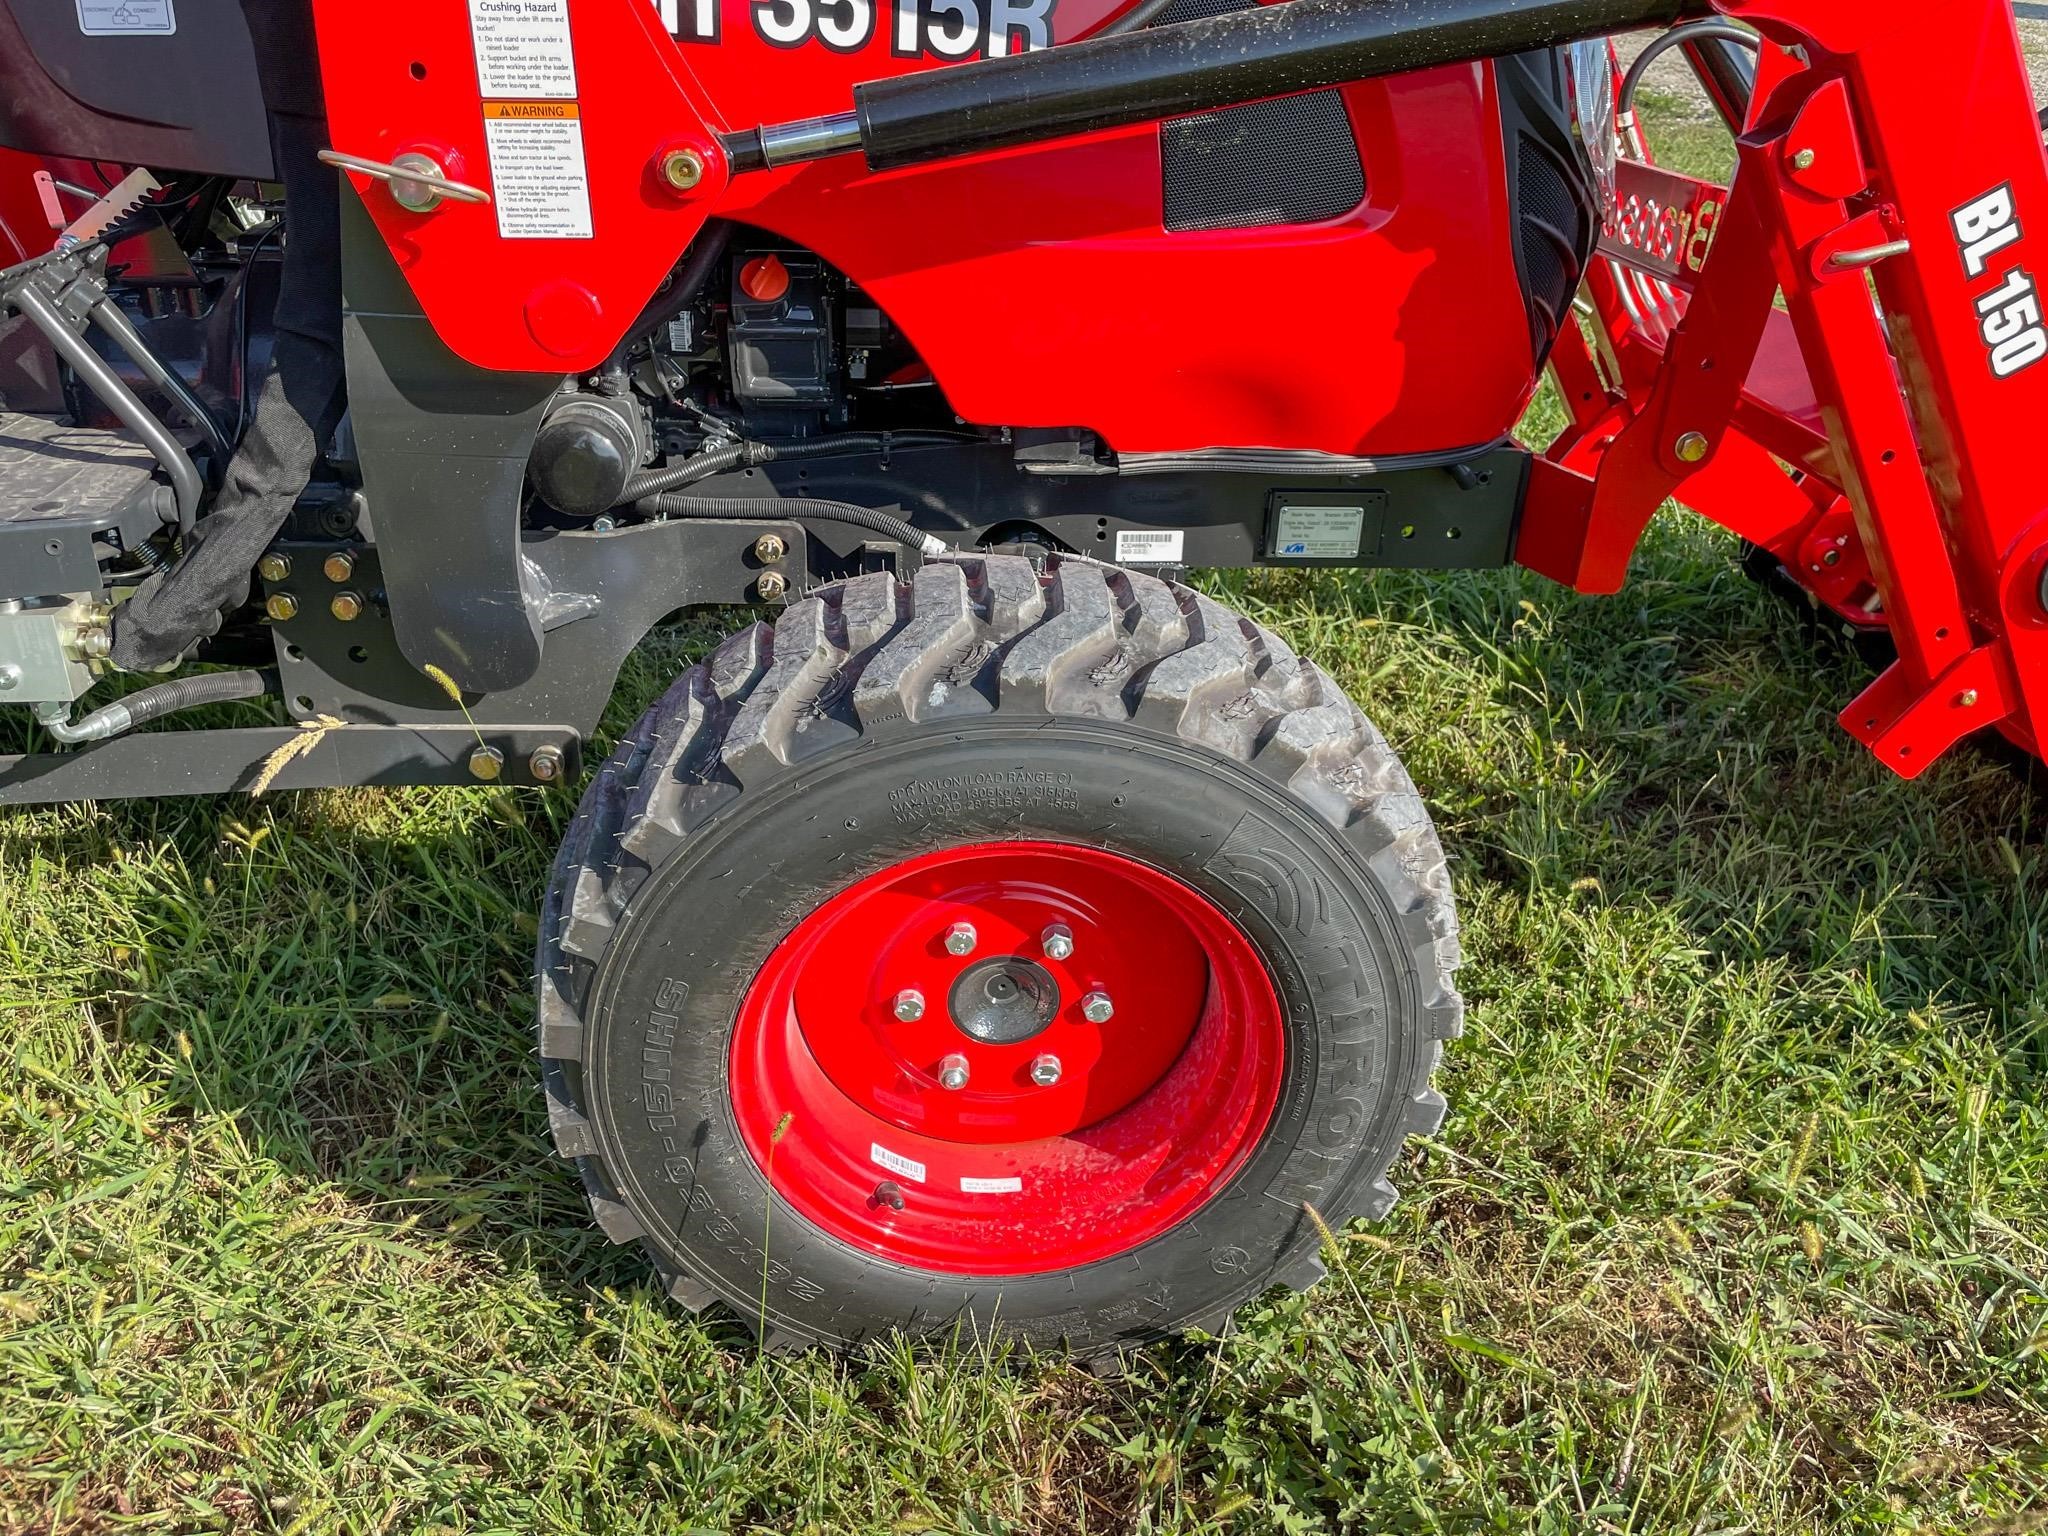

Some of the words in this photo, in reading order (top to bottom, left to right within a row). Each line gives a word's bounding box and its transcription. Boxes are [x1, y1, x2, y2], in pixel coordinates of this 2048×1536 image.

[480, 2, 521, 14] Crushing
[524, 2, 557, 12] Hazard
[475, 15, 487, 23] Stay
[509, 82, 528, 90] leaving
[552, 74, 571, 82] ground
[511, 105, 565, 117] WARNING
[1950, 183, 2021, 279] BL
[1975, 267, 2048, 378] 150
[887, 785, 917, 801] 6PR
[919, 777, 962, 794] NYLON
[963, 772, 1004, 787] (LOAD
[1006, 771, 1053, 784] RANGE
[924, 792, 960, 806] LOAD
[1014, 786, 1032, 798] AT
[929, 802, 962, 817] LOAD
[1025, 796, 1043, 807] AT
[1280, 941, 1377, 1198] TIRON
